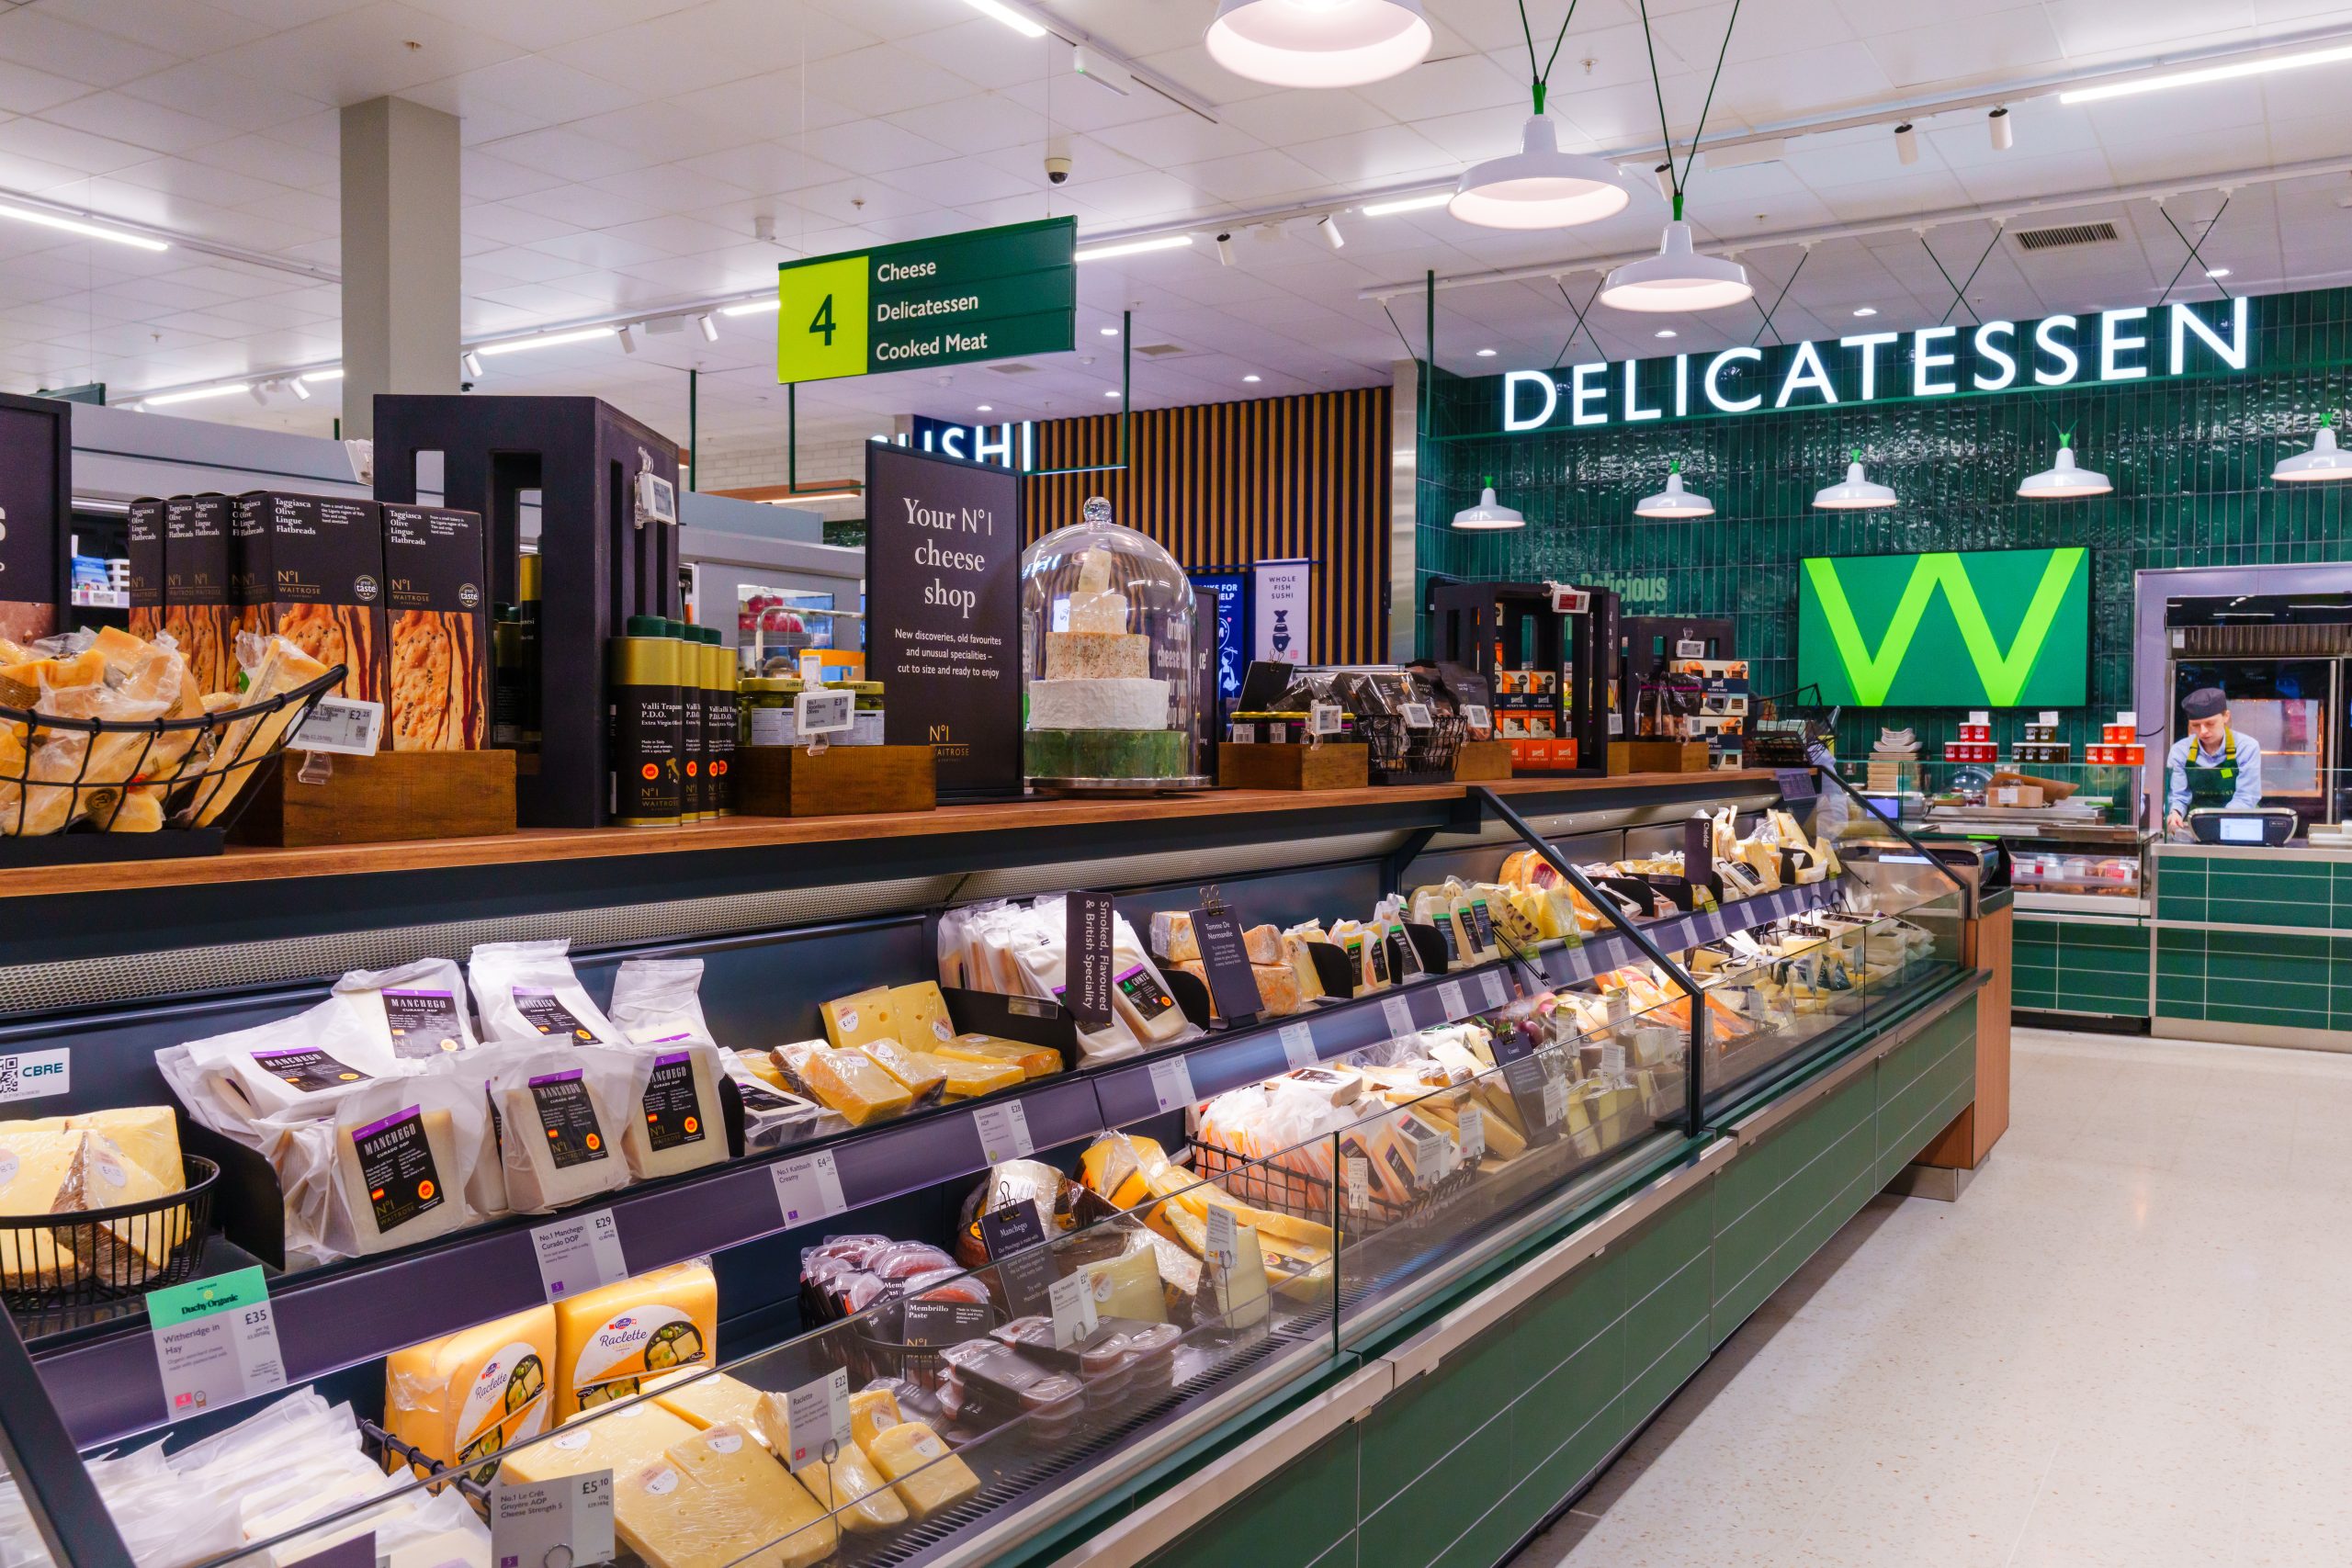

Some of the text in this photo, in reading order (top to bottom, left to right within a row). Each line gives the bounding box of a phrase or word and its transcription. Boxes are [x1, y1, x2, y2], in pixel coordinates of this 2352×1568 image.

[877, 262, 936, 283] Cheese
[877, 294, 978, 321] Delicatessen
[808, 294, 836, 345] 4
[876, 333, 988, 360] Cooked Meat
[1504, 296, 2247, 432] DELICATESSEN
[871, 421, 1031, 471] SHI
[169, 505, 192, 513] Taggiasca
[195, 502, 218, 511] Taggiasca
[274, 497, 311, 508] Taggiasca
[131, 508, 154, 516] Taggiasca
[276, 507, 296, 516] Olive
[390, 510, 422, 520] Taggiasca
[902, 498, 956, 530] Your
[169, 522, 186, 532] Lingue
[195, 520, 211, 529] Lingue
[241, 519, 256, 529] Lingue
[276, 516, 303, 526] Lingue
[390, 519, 409, 528] Olive
[131, 525, 148, 534] Lingue
[169, 530, 194, 538] Flatbreads
[195, 528, 220, 536] Flatbreads
[241, 526, 265, 536] Flatbreads
[277, 525, 316, 535] Flatbreads
[391, 527, 414, 536] Lingue
[391, 536, 426, 546] Flatbreads
[915, 539, 985, 571] cheese
[279, 587, 321, 595] WAITROSE
[356, 584, 378, 593] taste
[393, 594, 430, 603] WAITROSE
[460, 592, 479, 601] taste
[924, 579, 976, 618] shop
[1804, 547, 2088, 706] W
[895, 628, 1001, 646] New discoveries, old favourites
[906, 648, 987, 661] and unusual specialities
[898, 665, 1000, 680] cut to size and ready to enjoy
[935, 748, 970, 756] AITROSE
[1208, 930, 1233, 939] Normandie
[1083, 900, 1095, 1009] & British Speciality
[1099, 901, 1110, 1011] Smoked, Flavoured
[1131, 970, 1150, 986] COMTÉ
[391, 998, 446, 1009] MANCHEGO
[519, 999, 556, 1009] MANCHEGO
[265, 1053, 322, 1067] MANCHEGO
[23, 1062, 63, 1077] CBRE
[539, 1084, 581, 1100] MANCHEGO
[364, 1123, 416, 1156] MANCHEGO
[790, 1162, 811, 1172] Kaltbach
[779, 1174, 799, 1184] Creamy
[596, 1216, 611, 1229] £29
[554, 1226, 584, 1238] Manchego
[1000, 1222, 1028, 1238] Manchego
[542, 1235, 579, 1250] Curado DOP
[182, 1294, 238, 1315] Duchy Organic
[245, 1309, 267, 1325] £35
[164, 1326, 211, 1344] Witheridge
[599, 1329, 648, 1347] Raclette
[165, 1345, 183, 1355] Hay
[475, 1372, 508, 1399] Raclette
[835, 1375, 846, 1389] £22
[793, 1392, 813, 1406] Raclette
[582, 1478, 609, 1495] £5.10
[501, 1495, 516, 1503] No.1
[529, 1490, 544, 1498] Crêt
[501, 1502, 528, 1511] Gruyère
[501, 1509, 526, 1518] Cheese
[528, 1505, 557, 1516] Strength
